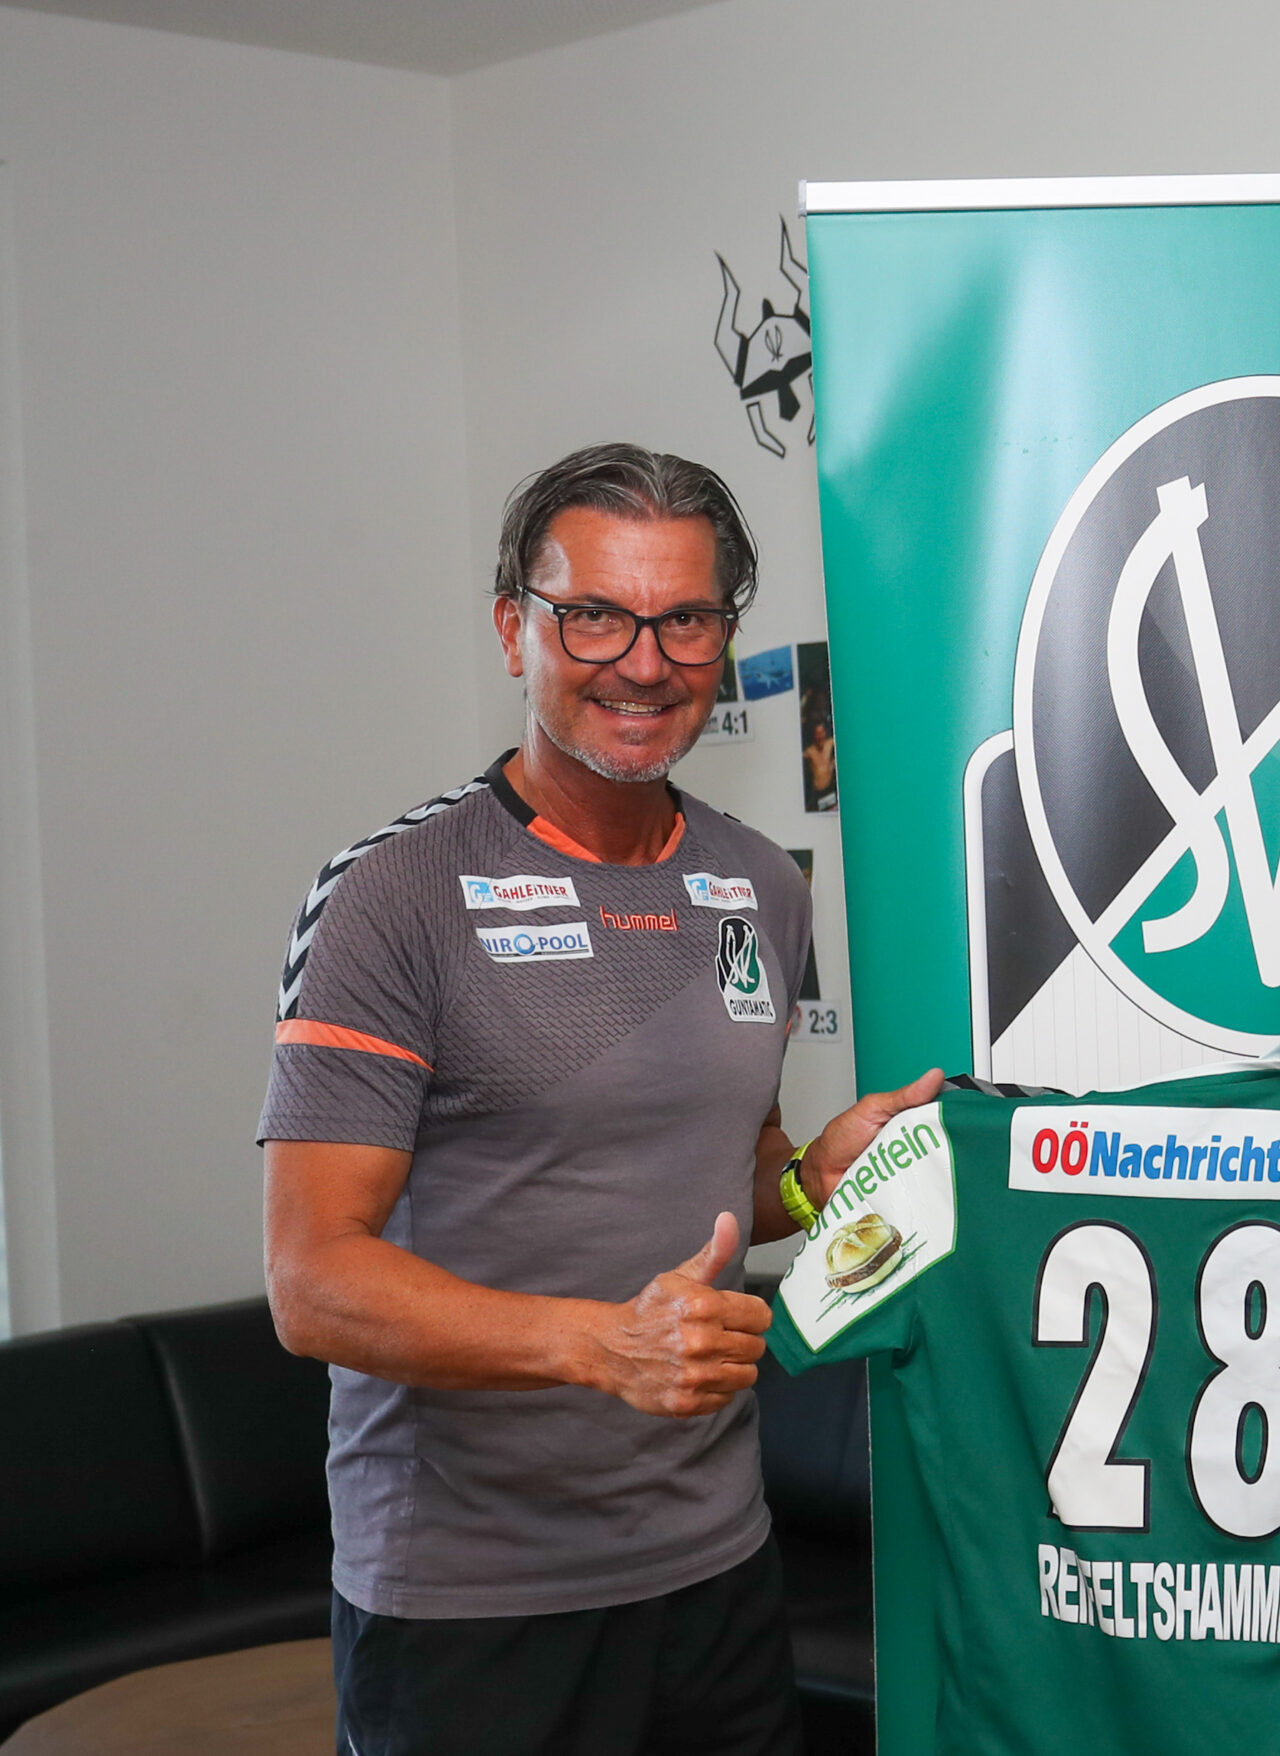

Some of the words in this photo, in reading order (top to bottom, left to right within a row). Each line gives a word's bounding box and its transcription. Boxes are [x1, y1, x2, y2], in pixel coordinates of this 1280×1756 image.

[722, 710, 748, 735] 4:1
[599, 905, 678, 931] hummel
[729, 999, 774, 1018] GUNTAMATIC
[809, 1009, 837, 1034] 2:3
